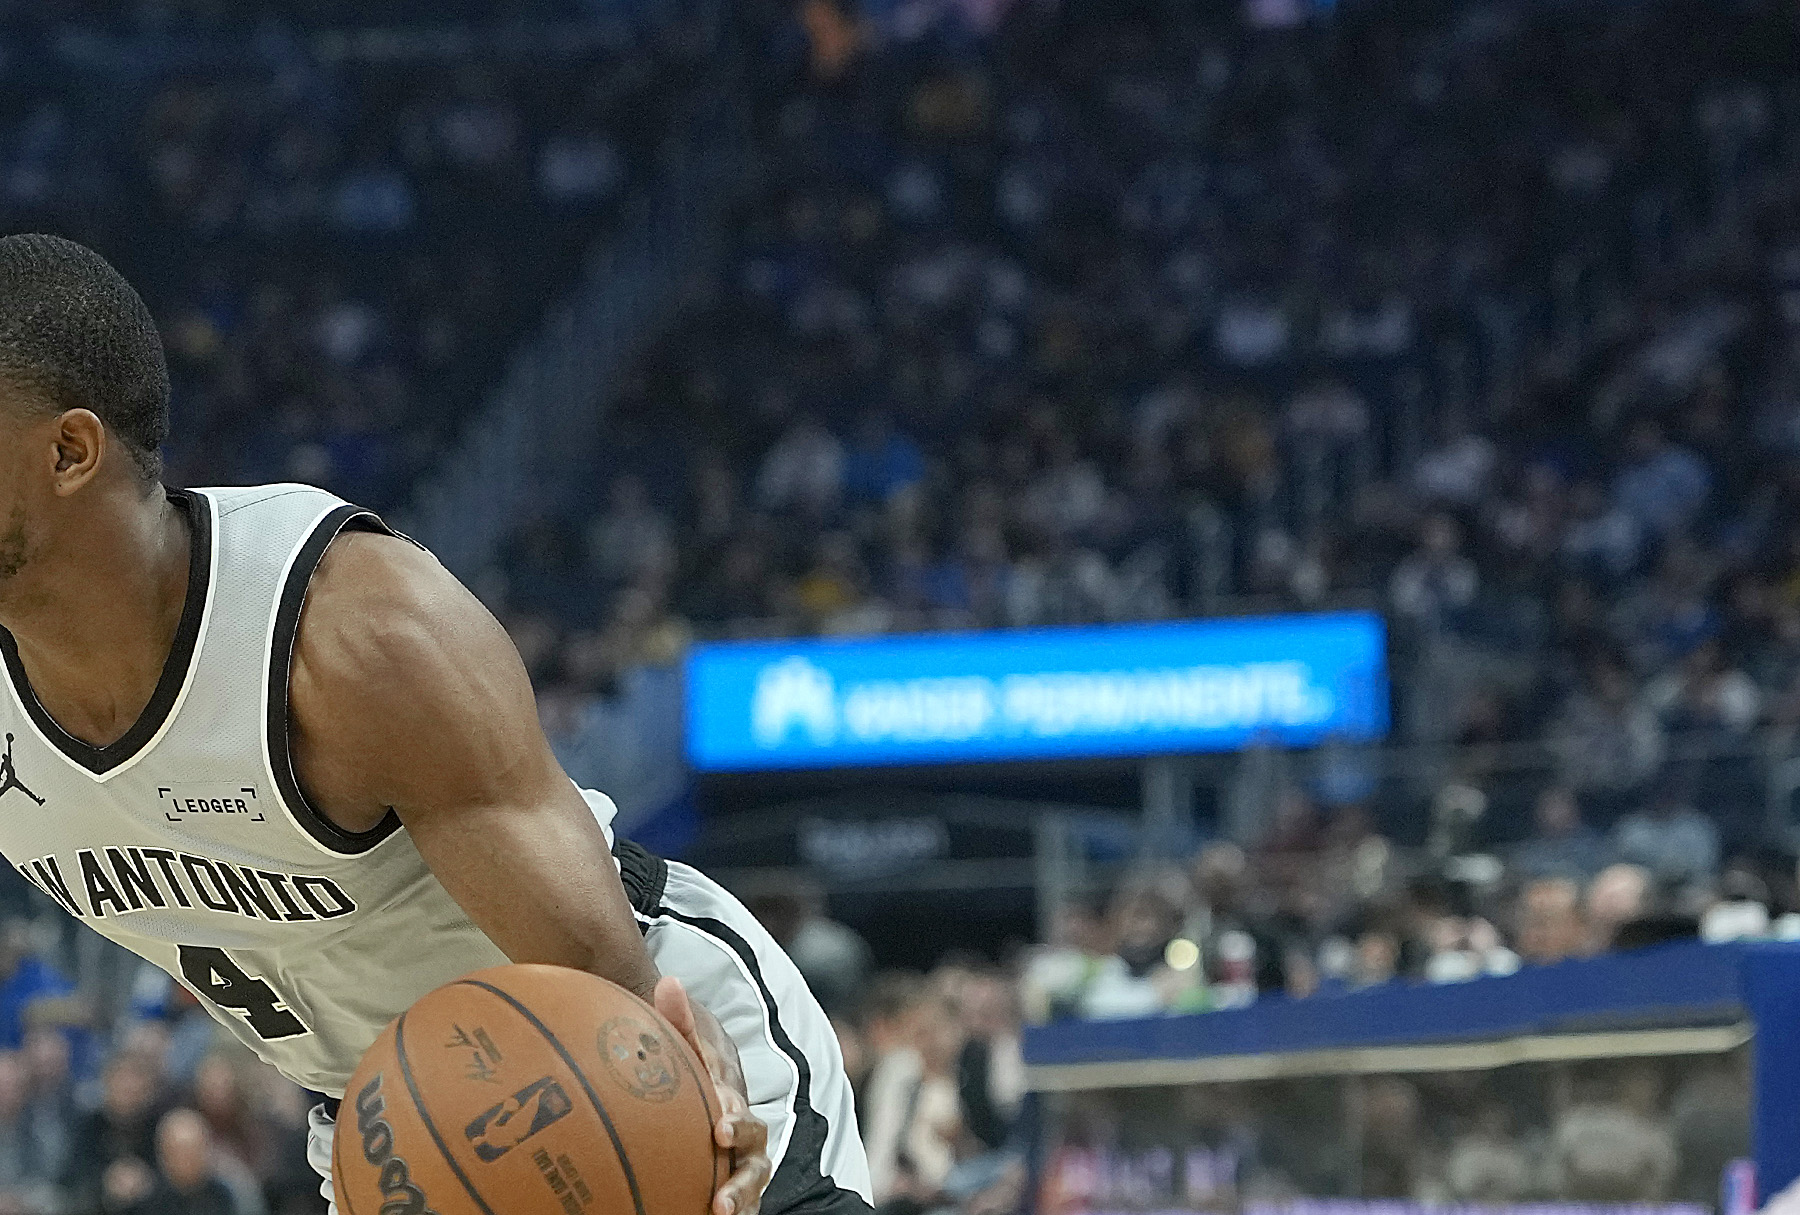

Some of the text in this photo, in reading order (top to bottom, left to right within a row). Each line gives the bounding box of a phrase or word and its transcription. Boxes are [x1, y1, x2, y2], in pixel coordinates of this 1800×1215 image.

[172, 798, 249, 815] LEDGER
[76, 846, 359, 922] ANTONIO
[173, 944, 314, 1041] 4
